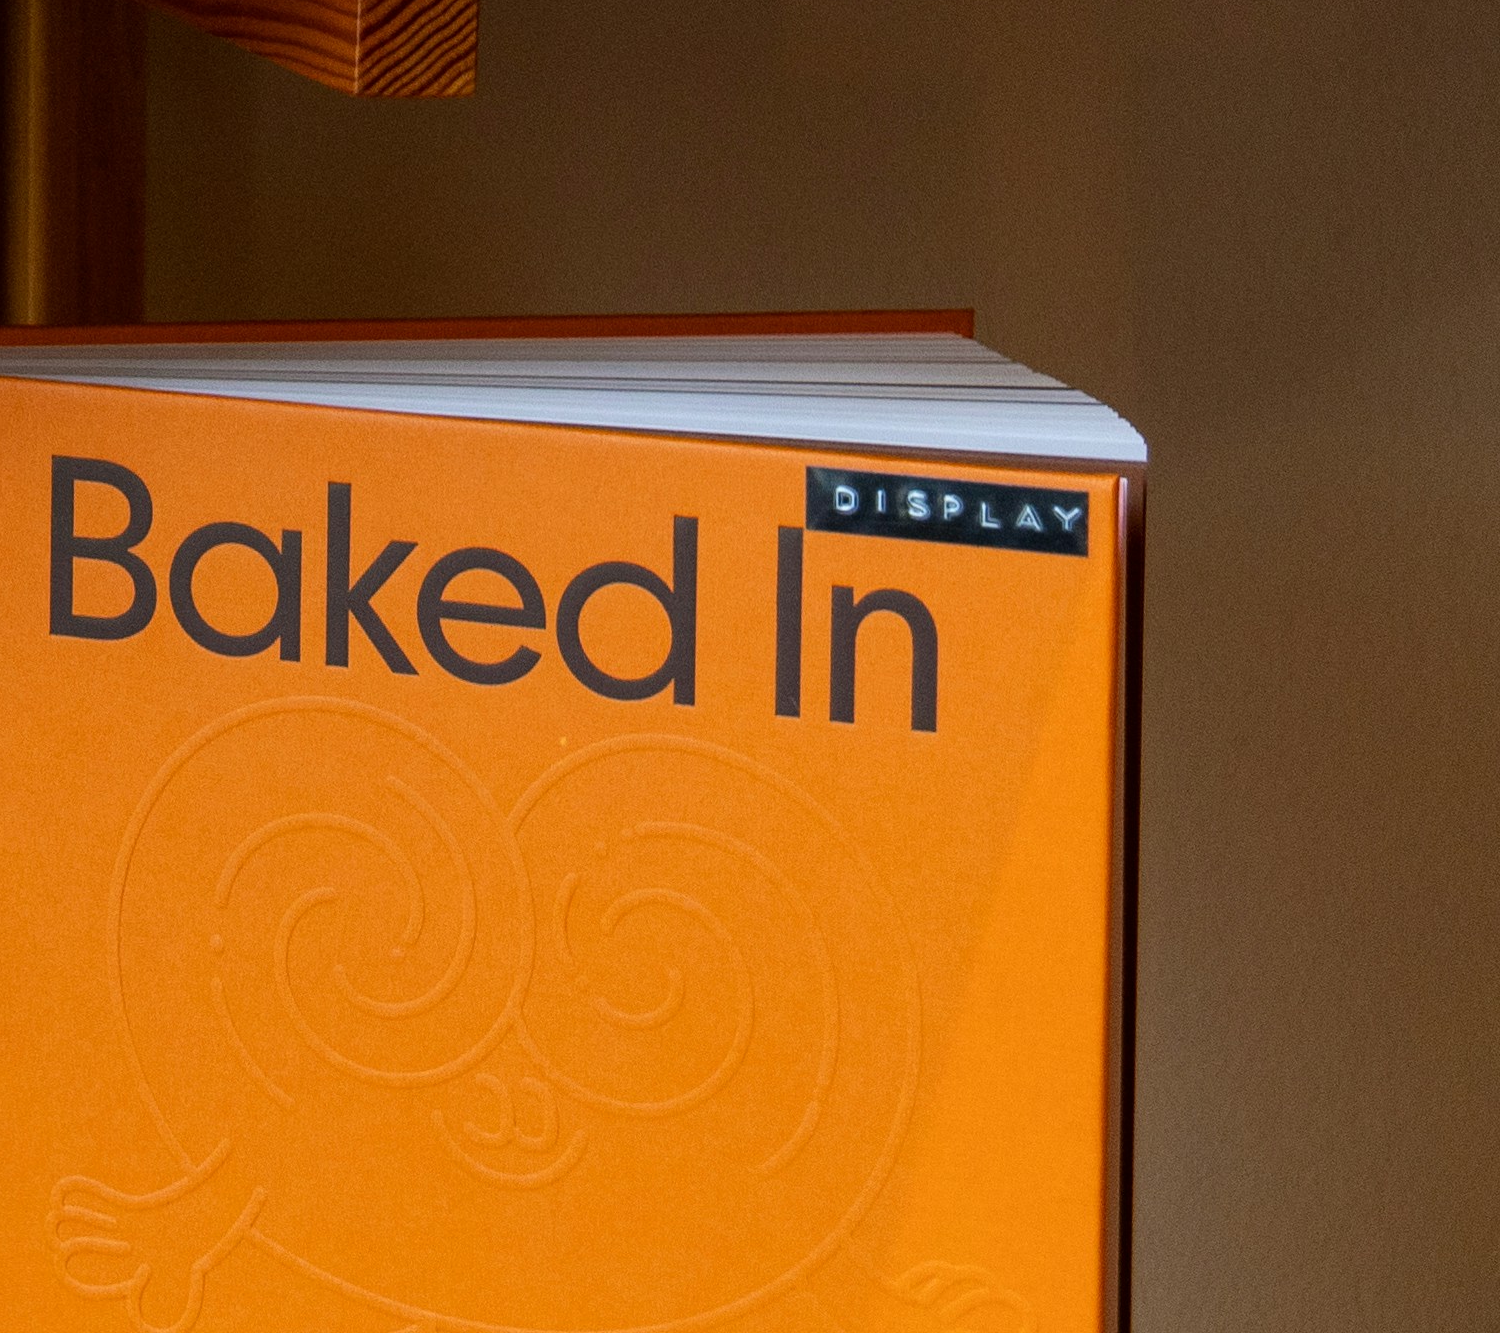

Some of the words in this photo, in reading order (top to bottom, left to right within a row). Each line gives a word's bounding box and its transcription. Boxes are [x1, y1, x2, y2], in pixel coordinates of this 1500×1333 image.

[834, 484, 1083, 532] DISPLAY
[48, 454, 699, 708] Baked
[774, 525, 939, 733] In
